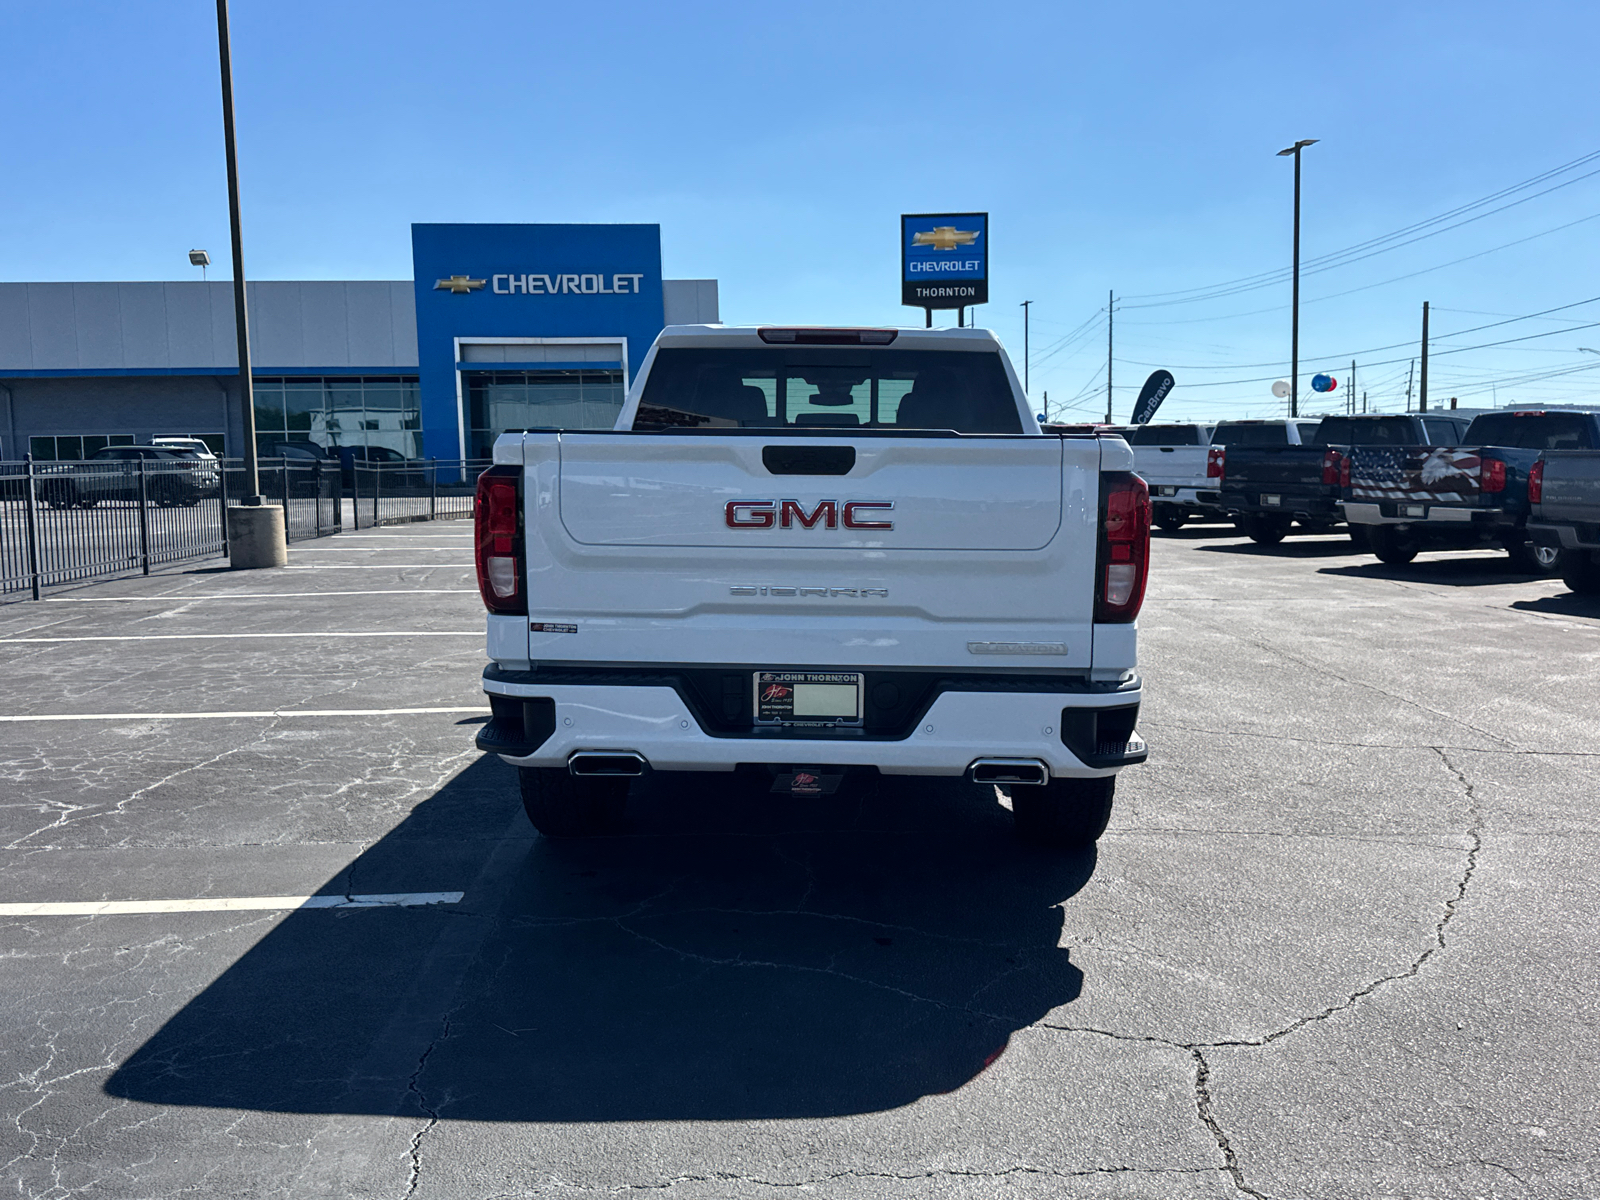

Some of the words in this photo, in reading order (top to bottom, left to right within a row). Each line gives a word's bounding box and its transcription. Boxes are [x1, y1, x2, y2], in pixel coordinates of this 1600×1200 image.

[910, 260, 980, 272] CHEVROLET
[492, 274, 644, 294] CHEVROLET
[916, 287, 975, 297] THORNTON
[1137, 378, 1171, 425] CarBravo
[724, 499, 895, 531] GMC
[730, 586, 889, 597] SIERRA
[975, 645, 1060, 653] ELEVATION
[780, 673, 805, 682] JOHN
[807, 674, 858, 682] THORNTON
